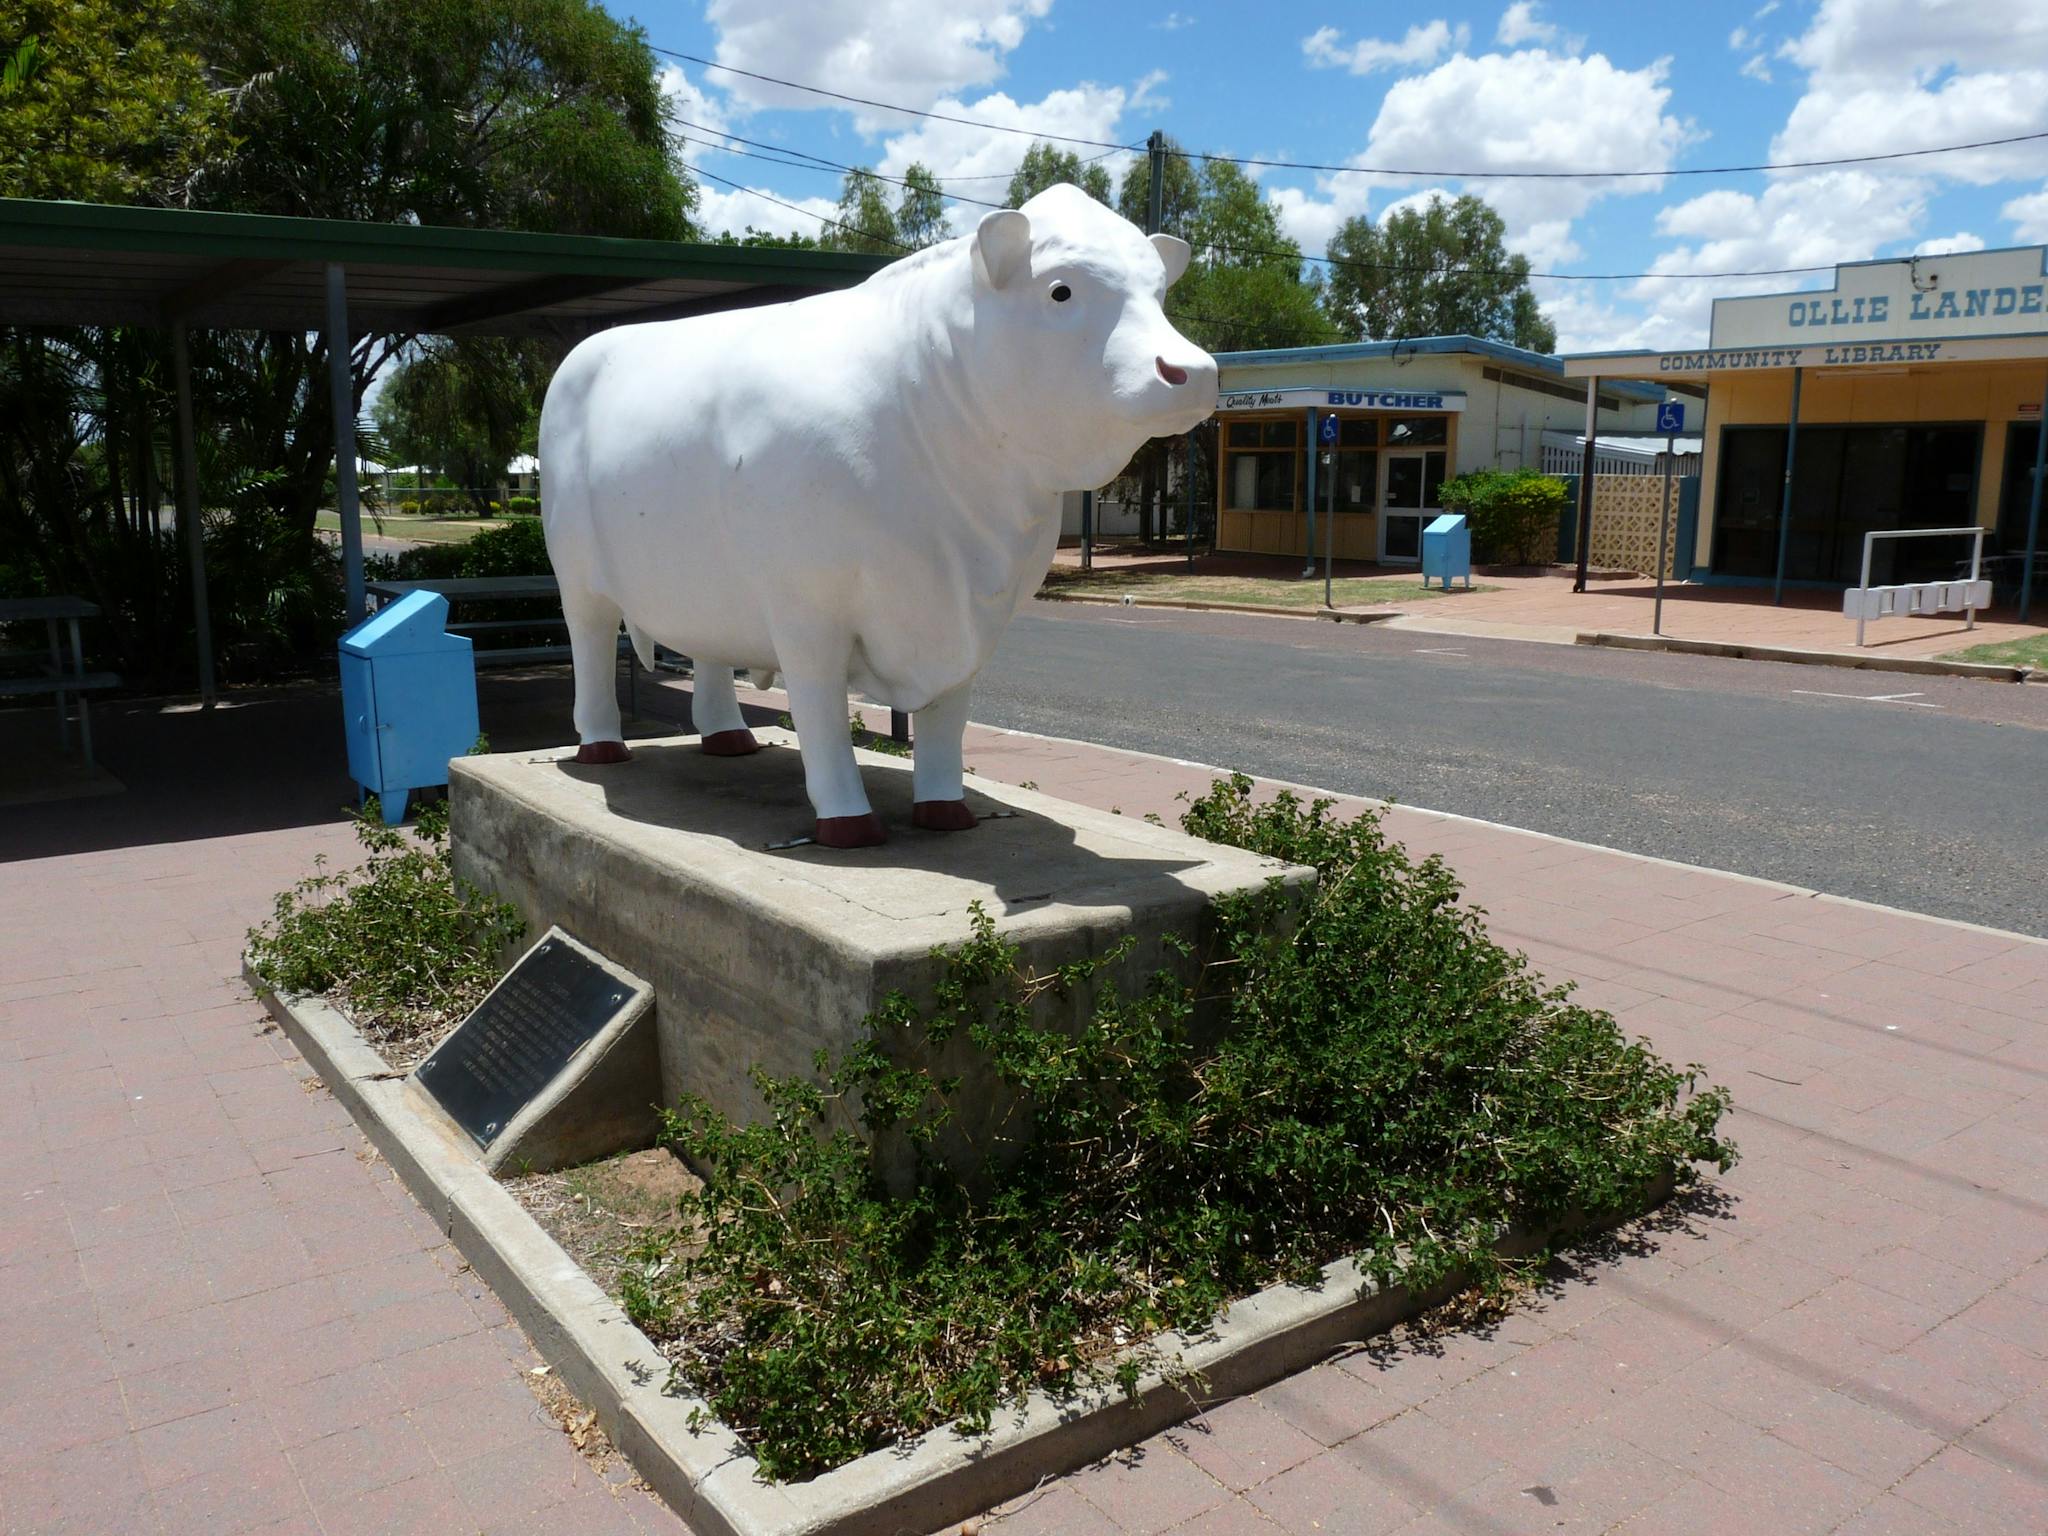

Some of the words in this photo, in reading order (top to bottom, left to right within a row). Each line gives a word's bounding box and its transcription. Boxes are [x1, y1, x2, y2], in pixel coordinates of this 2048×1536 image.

[1788, 295, 1889, 328] OLLIE
[1908, 284, 2048, 321] LANDE
[1659, 350, 1803, 371] COMMUNITY
[1824, 343, 1942, 364] LIBRARY
[1226, 393, 1257, 408] Quality
[1258, 391, 1284, 407] Meats
[1327, 391, 1444, 409] BUTCHER
